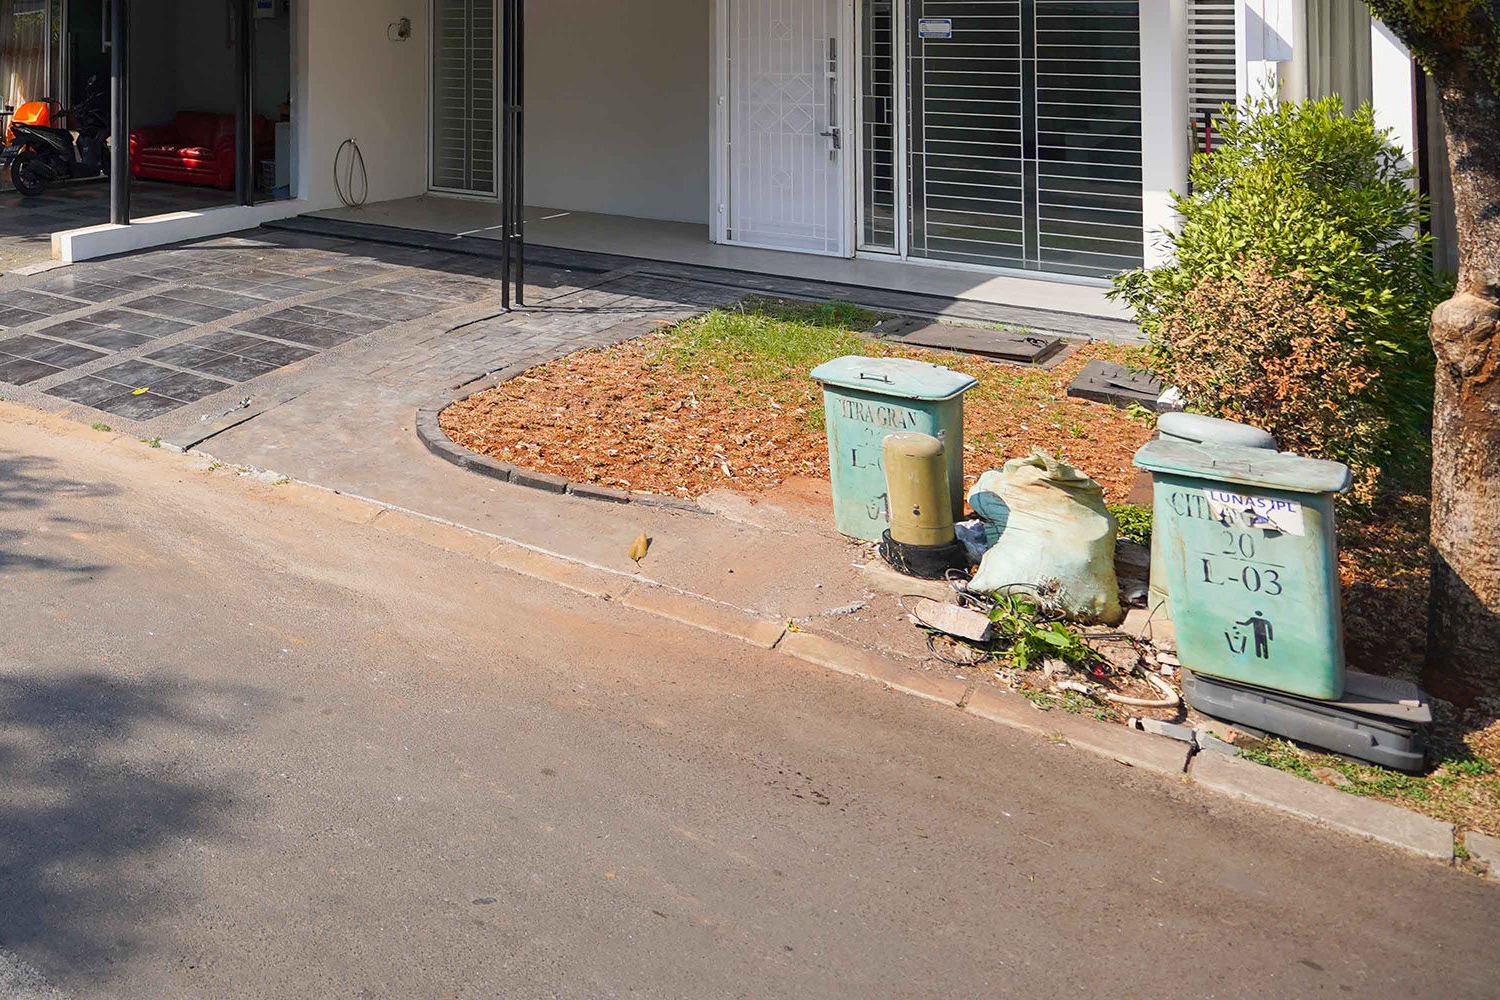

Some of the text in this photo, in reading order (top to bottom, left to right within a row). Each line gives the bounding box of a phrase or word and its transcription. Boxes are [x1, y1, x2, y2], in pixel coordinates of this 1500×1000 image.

[851, 448, 883, 472] L-
[1210, 490, 1266, 509] LUNAS
[1220, 530, 1255, 559] 20
[1201, 558, 1283, 596] L-03
